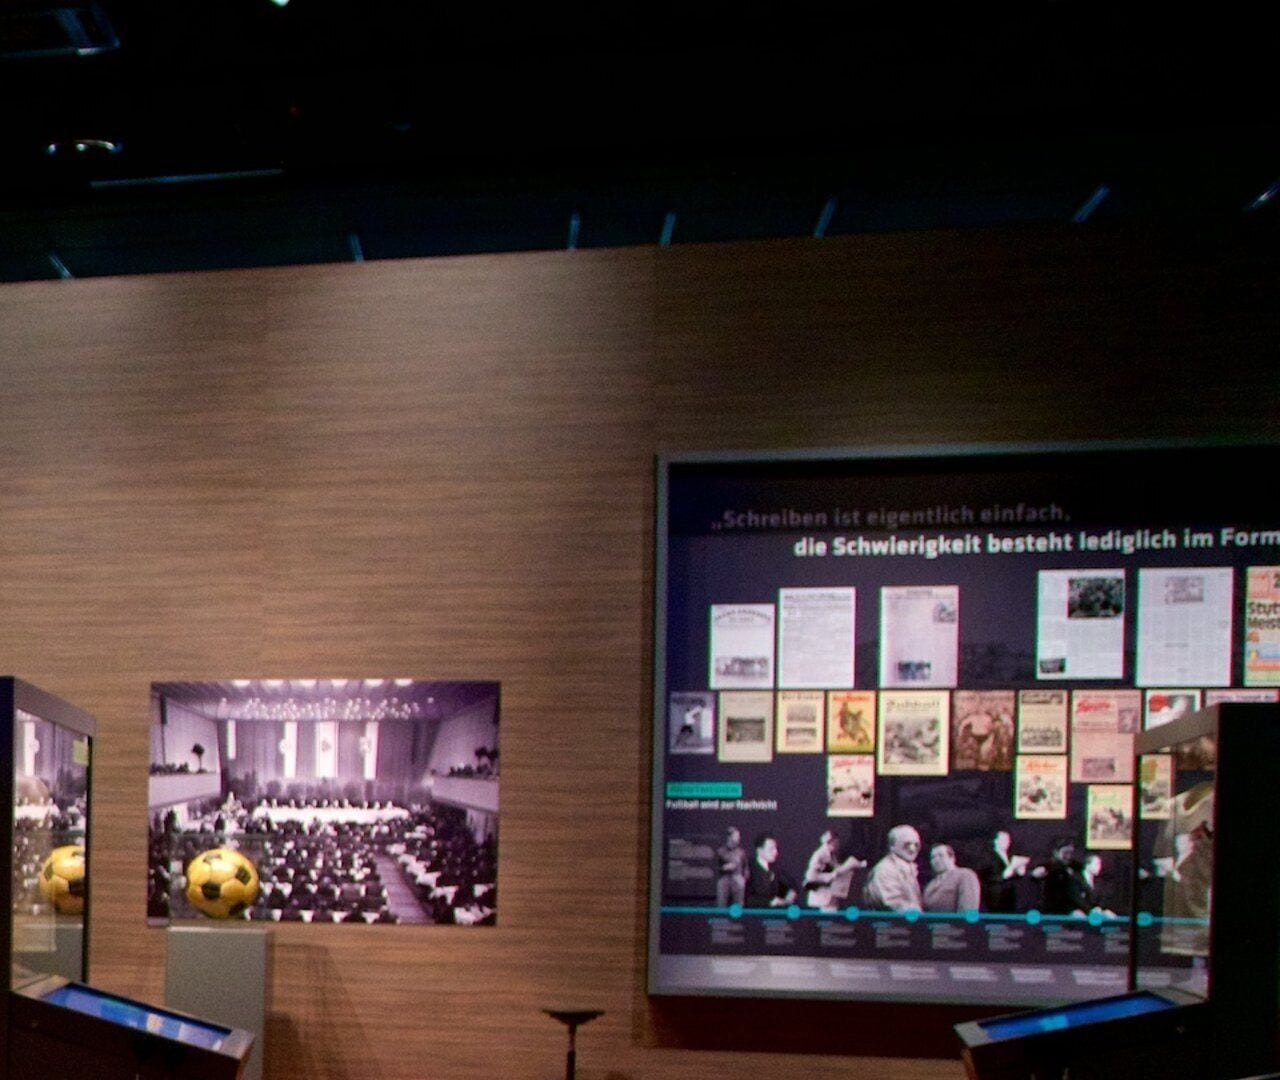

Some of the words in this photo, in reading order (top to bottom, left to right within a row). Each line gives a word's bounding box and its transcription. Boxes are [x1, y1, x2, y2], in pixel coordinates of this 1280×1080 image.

[833, 508, 860, 525] ist
[866, 505, 975, 531] eigentlich
[794, 537, 827, 557] die
[833, 534, 982, 560] Schwierigkeit
[987, 531, 1073, 553] besteht
[1080, 530, 1176, 556] lediglich
[1183, 529, 1213, 548] im
